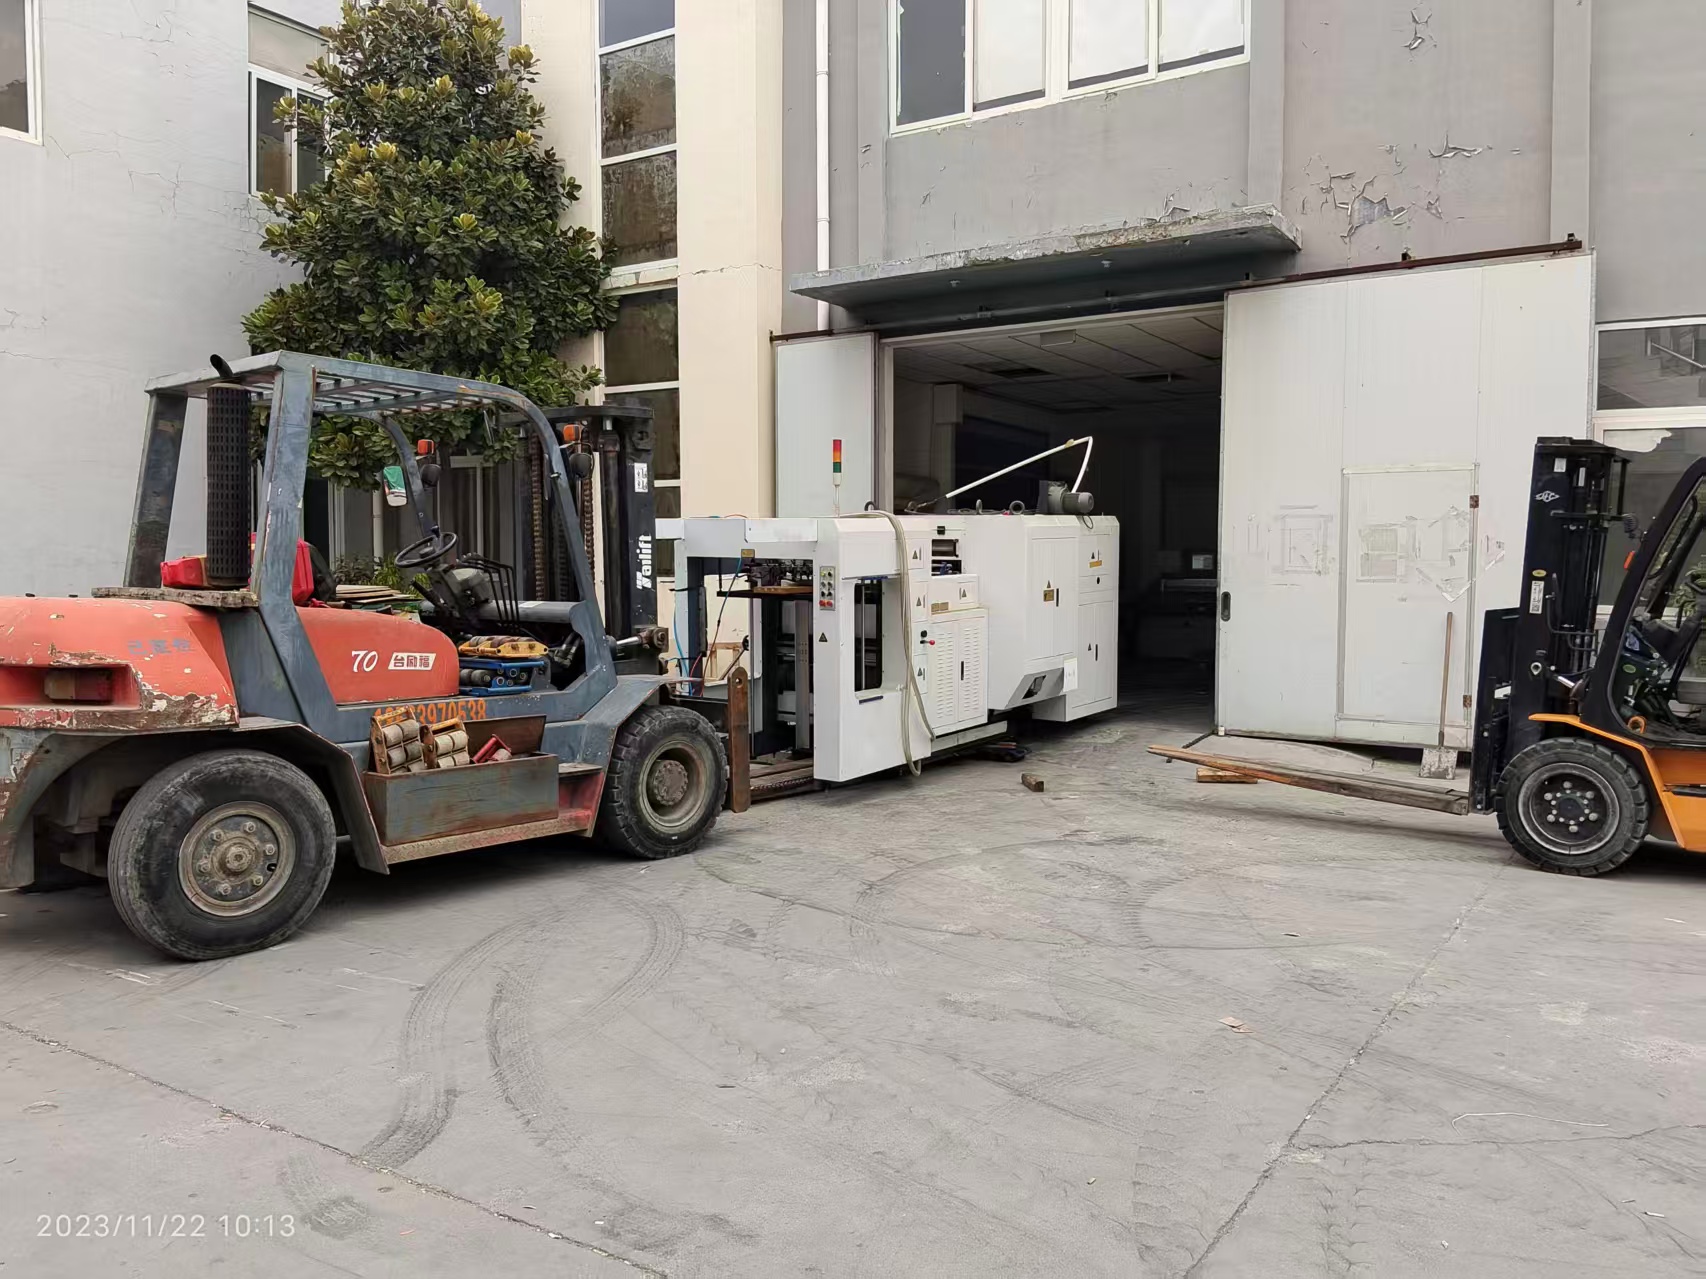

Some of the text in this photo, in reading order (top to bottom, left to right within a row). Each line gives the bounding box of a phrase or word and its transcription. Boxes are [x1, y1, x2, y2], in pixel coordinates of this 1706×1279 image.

[352, 650, 378, 673] 70
[393, 654, 430, 668] 台励福
